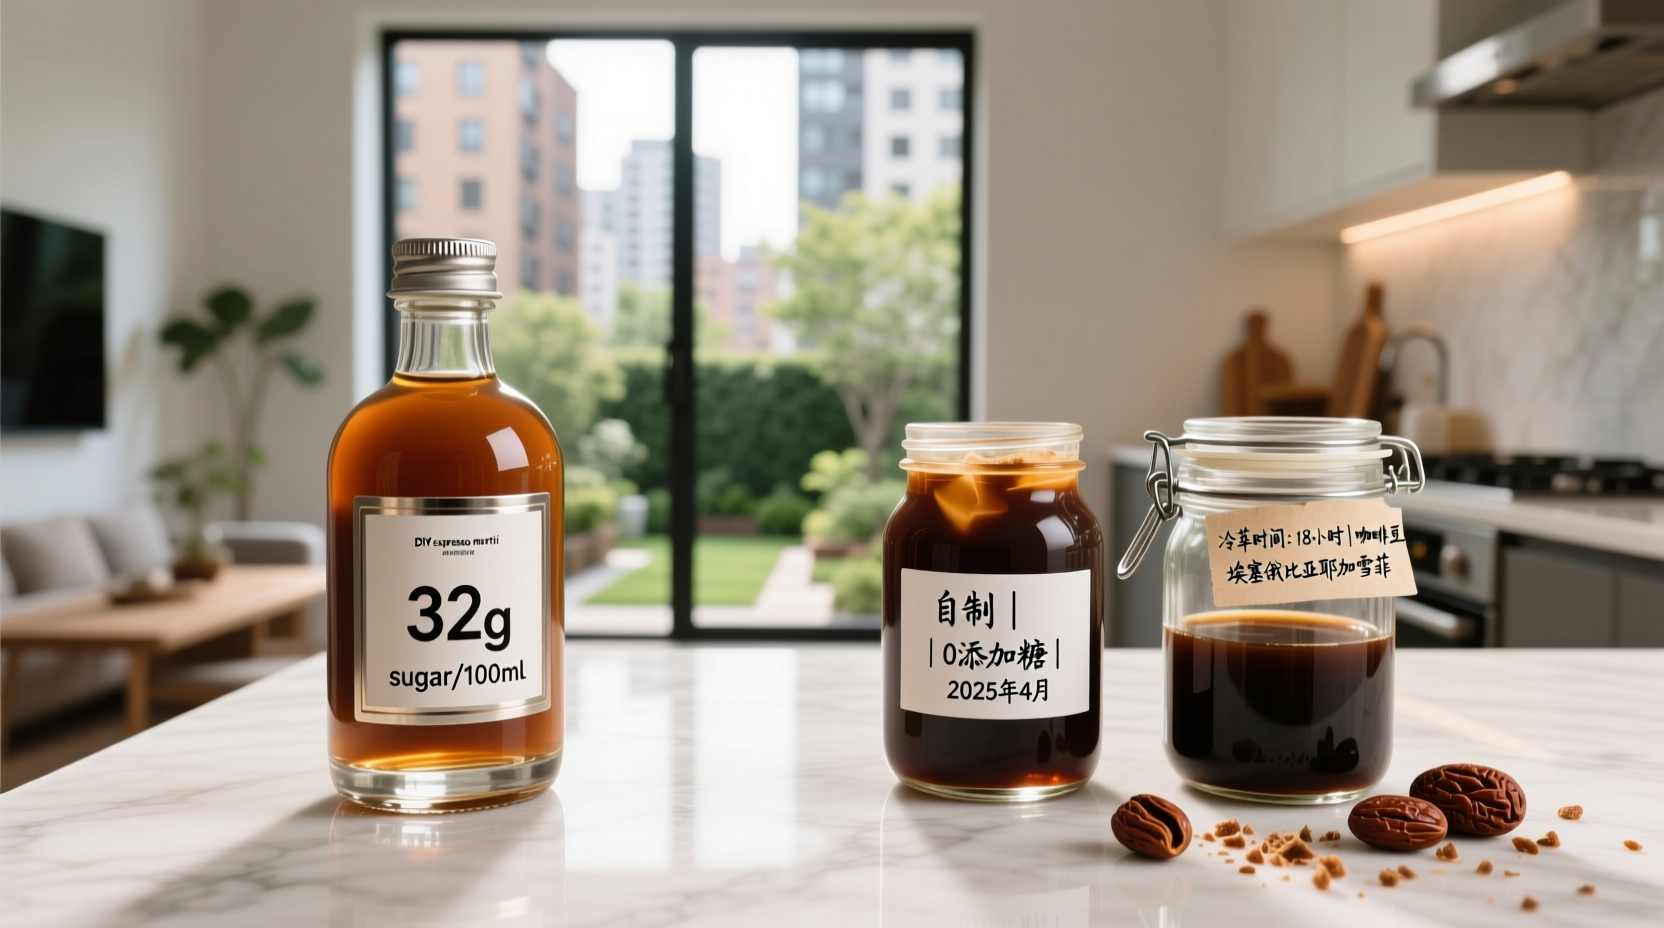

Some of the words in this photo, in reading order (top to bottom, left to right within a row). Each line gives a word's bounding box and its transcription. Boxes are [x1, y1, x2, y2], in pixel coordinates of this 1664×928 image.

[414, 536, 432, 548] DIY
[406, 584, 511, 652] 32g
[937, 589, 995, 630] 自制
[389, 659, 527, 693] sugar/100ml
[946, 678, 1049, 705] 2025年4月
